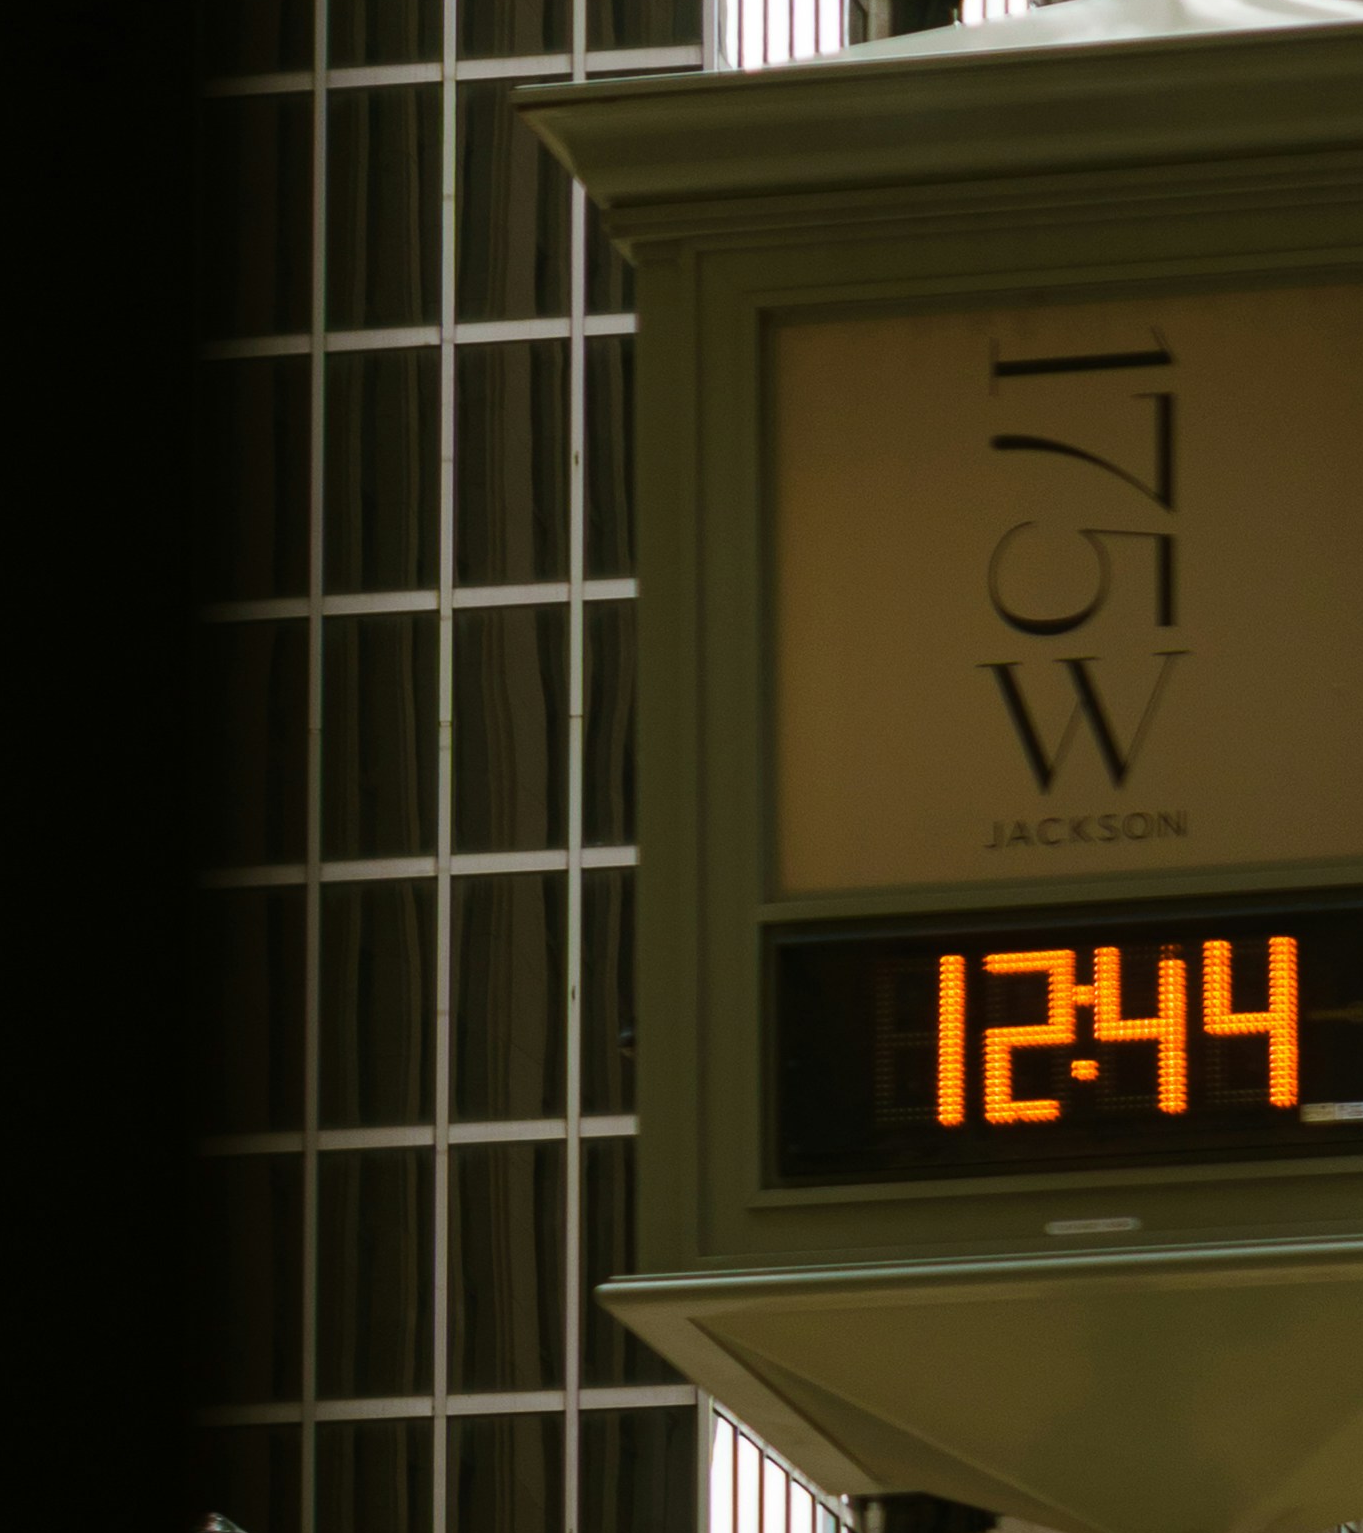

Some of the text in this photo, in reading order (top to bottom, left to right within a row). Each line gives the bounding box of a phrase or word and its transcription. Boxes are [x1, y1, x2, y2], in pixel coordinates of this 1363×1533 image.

[977, 325, 1192, 795] 175 W
[983, 810, 1189, 850] JACKSON
[937, 936, 1299, 1127] 12:44
